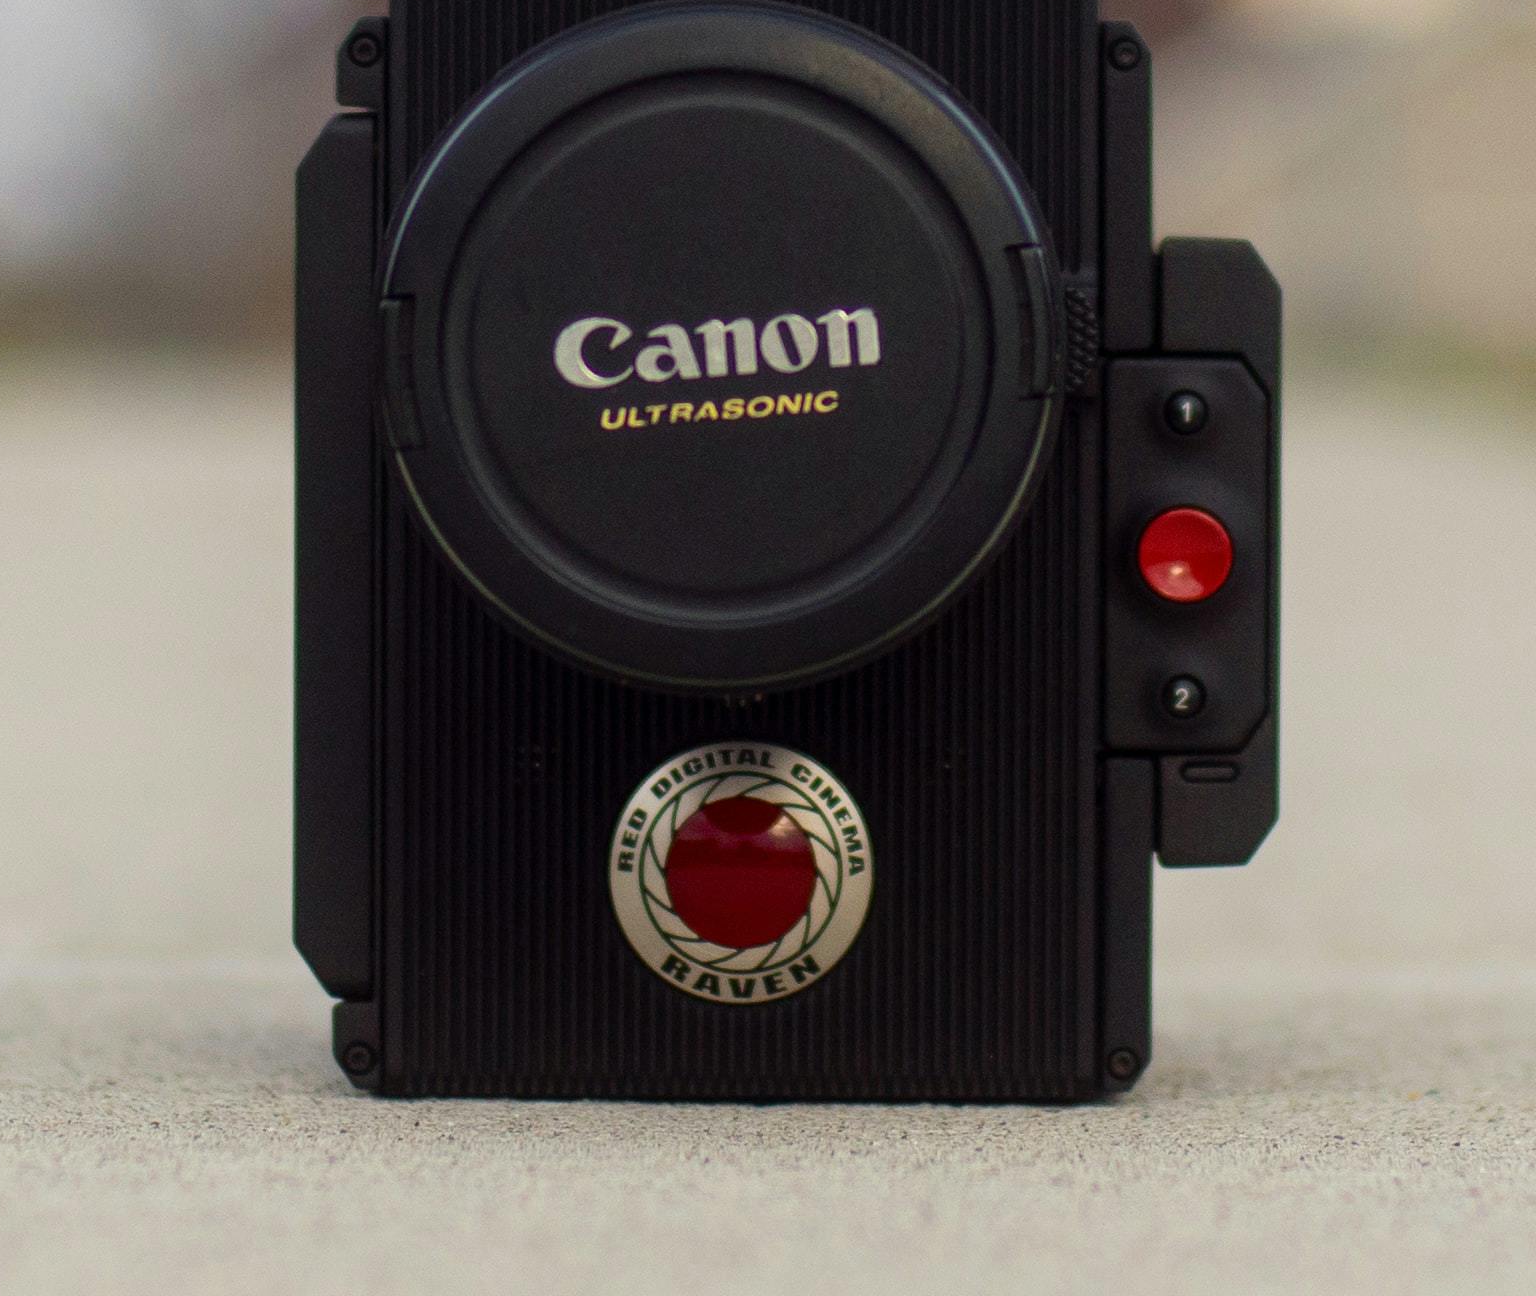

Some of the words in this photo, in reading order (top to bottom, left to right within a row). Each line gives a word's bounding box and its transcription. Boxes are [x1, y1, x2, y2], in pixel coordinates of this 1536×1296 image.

[554, 307, 881, 389] Canon
[600, 390, 839, 430] ULTRASONIC
[1181, 402, 1192, 423] 1
[1175, 688, 1189, 709] 2
[617, 807, 648, 873] RED
[650, 748, 777, 801] DIGITAL
[789, 763, 866, 877] CINEMA
[660, 953, 822, 999] RAVEN
